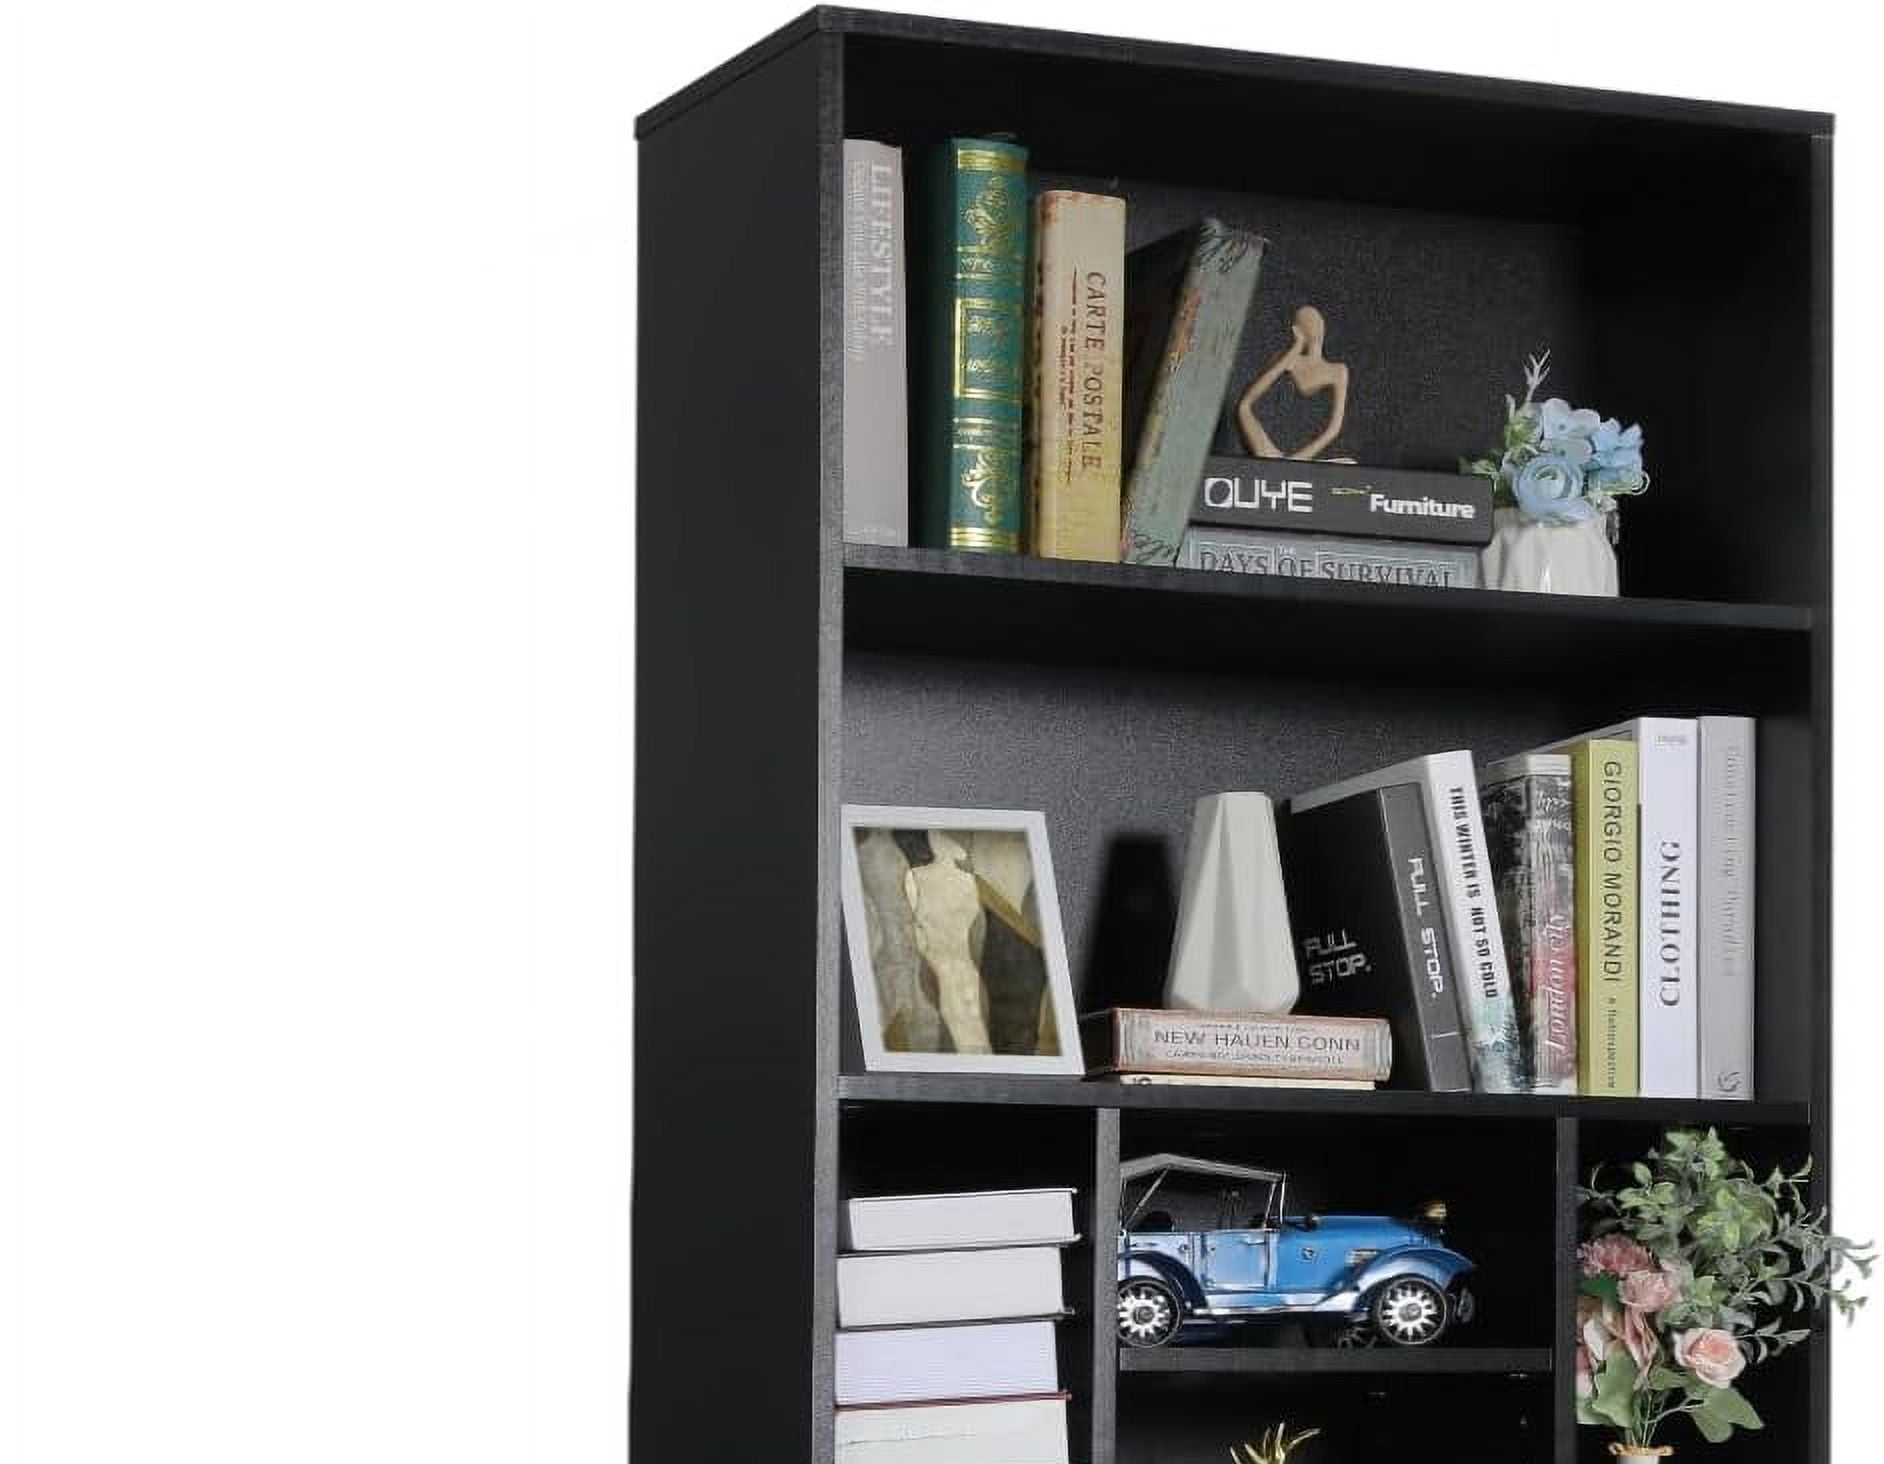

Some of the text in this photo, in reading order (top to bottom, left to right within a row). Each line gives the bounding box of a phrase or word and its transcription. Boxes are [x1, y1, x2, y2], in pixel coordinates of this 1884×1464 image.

[870, 160, 893, 348] LIFESTYLE
[1081, 271, 1107, 471] CARTE POSTALE
[1200, 550, 1268, 575] DAYS
[1204, 477, 1313, 513] OUYE
[1370, 493, 1476, 520] Furniture
[1450, 787, 1498, 998] THIS WINTER IS NOT SO COLD
[1603, 760, 1623, 982] GIORGIO MORANDI
[1658, 840, 1681, 1008] CLOTHING
[1154, 1029, 1206, 1046] NEW
